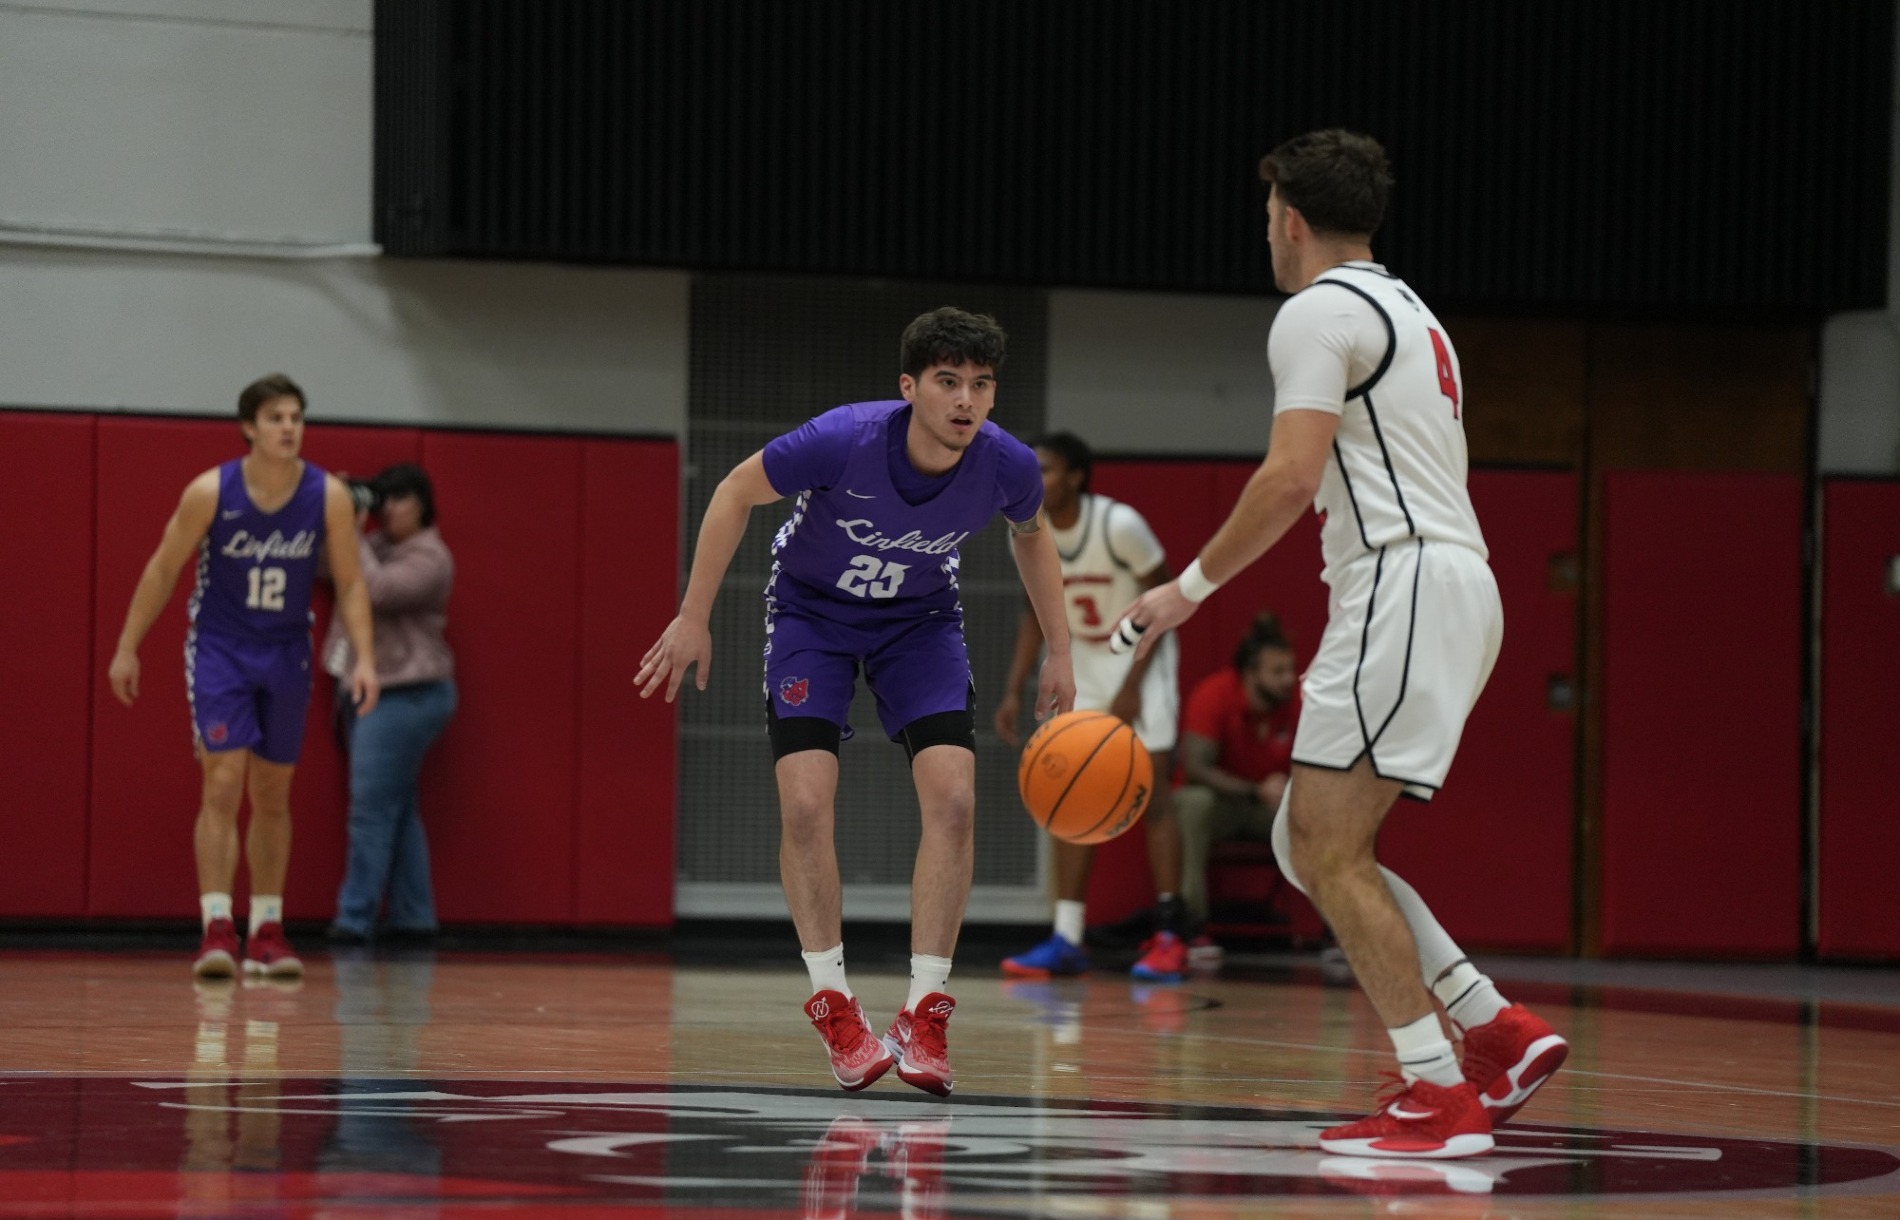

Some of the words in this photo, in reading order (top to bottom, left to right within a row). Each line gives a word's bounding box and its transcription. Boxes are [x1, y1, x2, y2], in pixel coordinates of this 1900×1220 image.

[1426, 326, 1459, 421] 4
[836, 518, 970, 555] Linfield
[246, 566, 287, 612] 12
